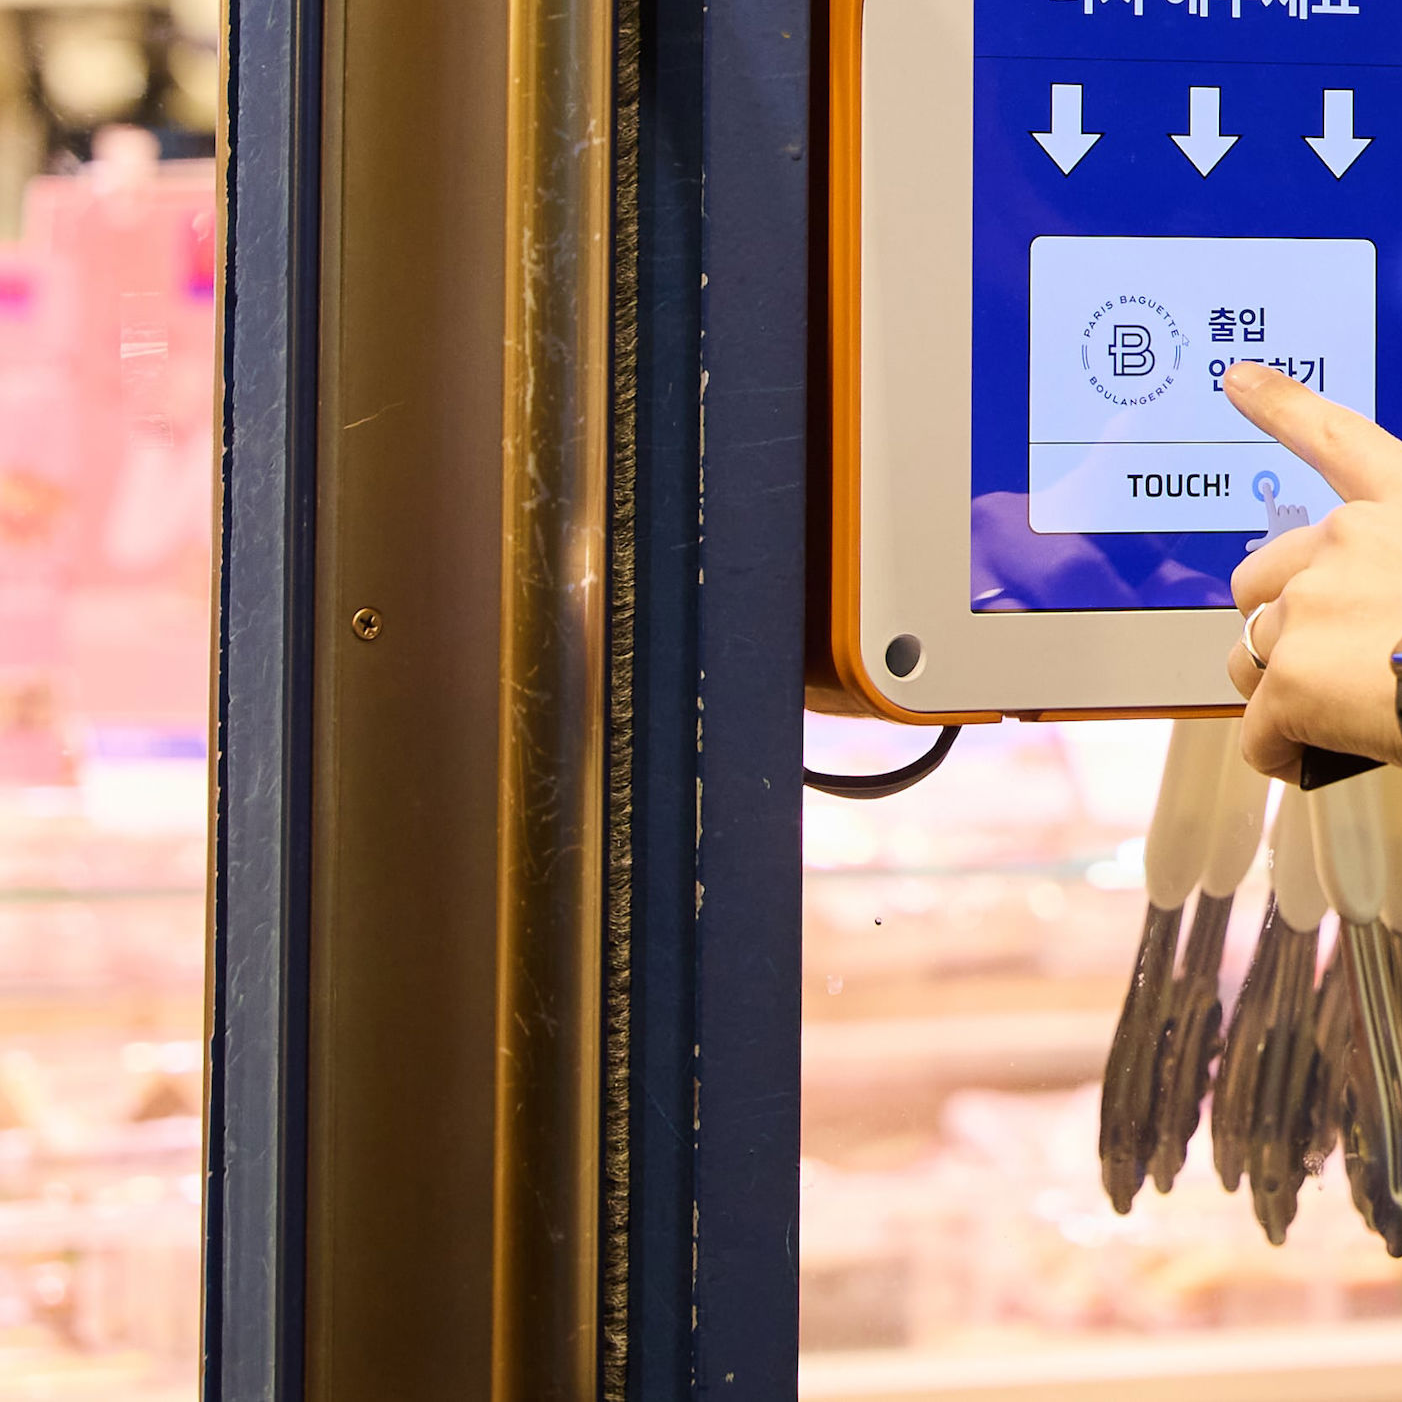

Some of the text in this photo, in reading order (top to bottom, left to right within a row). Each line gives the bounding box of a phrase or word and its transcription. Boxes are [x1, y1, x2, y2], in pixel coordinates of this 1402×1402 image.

[1083, 295, 1180, 339] PARIS BAGUETTE
[1208, 307, 1265, 343] 출입
[1089, 375, 1174, 406] BOULANGERIE
[1126, 473, 1230, 498] TOUCH!
